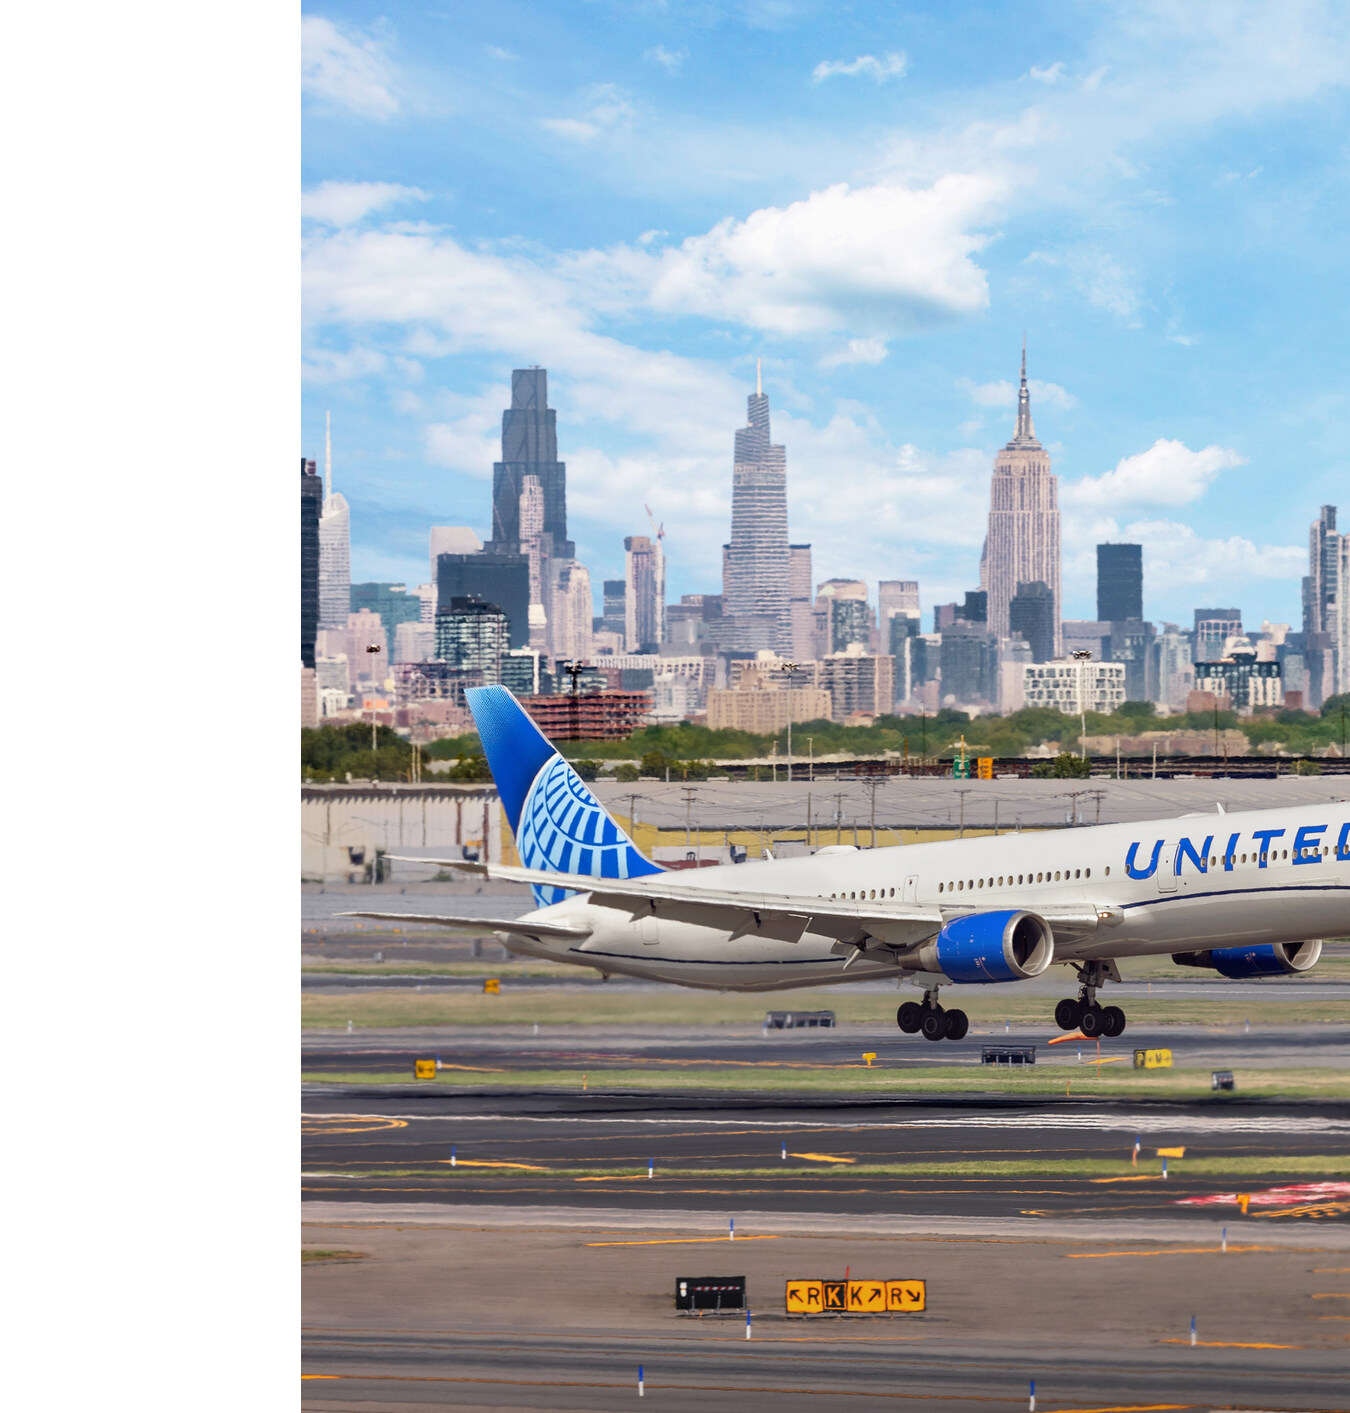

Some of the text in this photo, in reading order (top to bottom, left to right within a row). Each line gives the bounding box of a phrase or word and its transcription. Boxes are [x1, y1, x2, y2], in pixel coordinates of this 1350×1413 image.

[807, 1286, 902, 1306] R K K R
